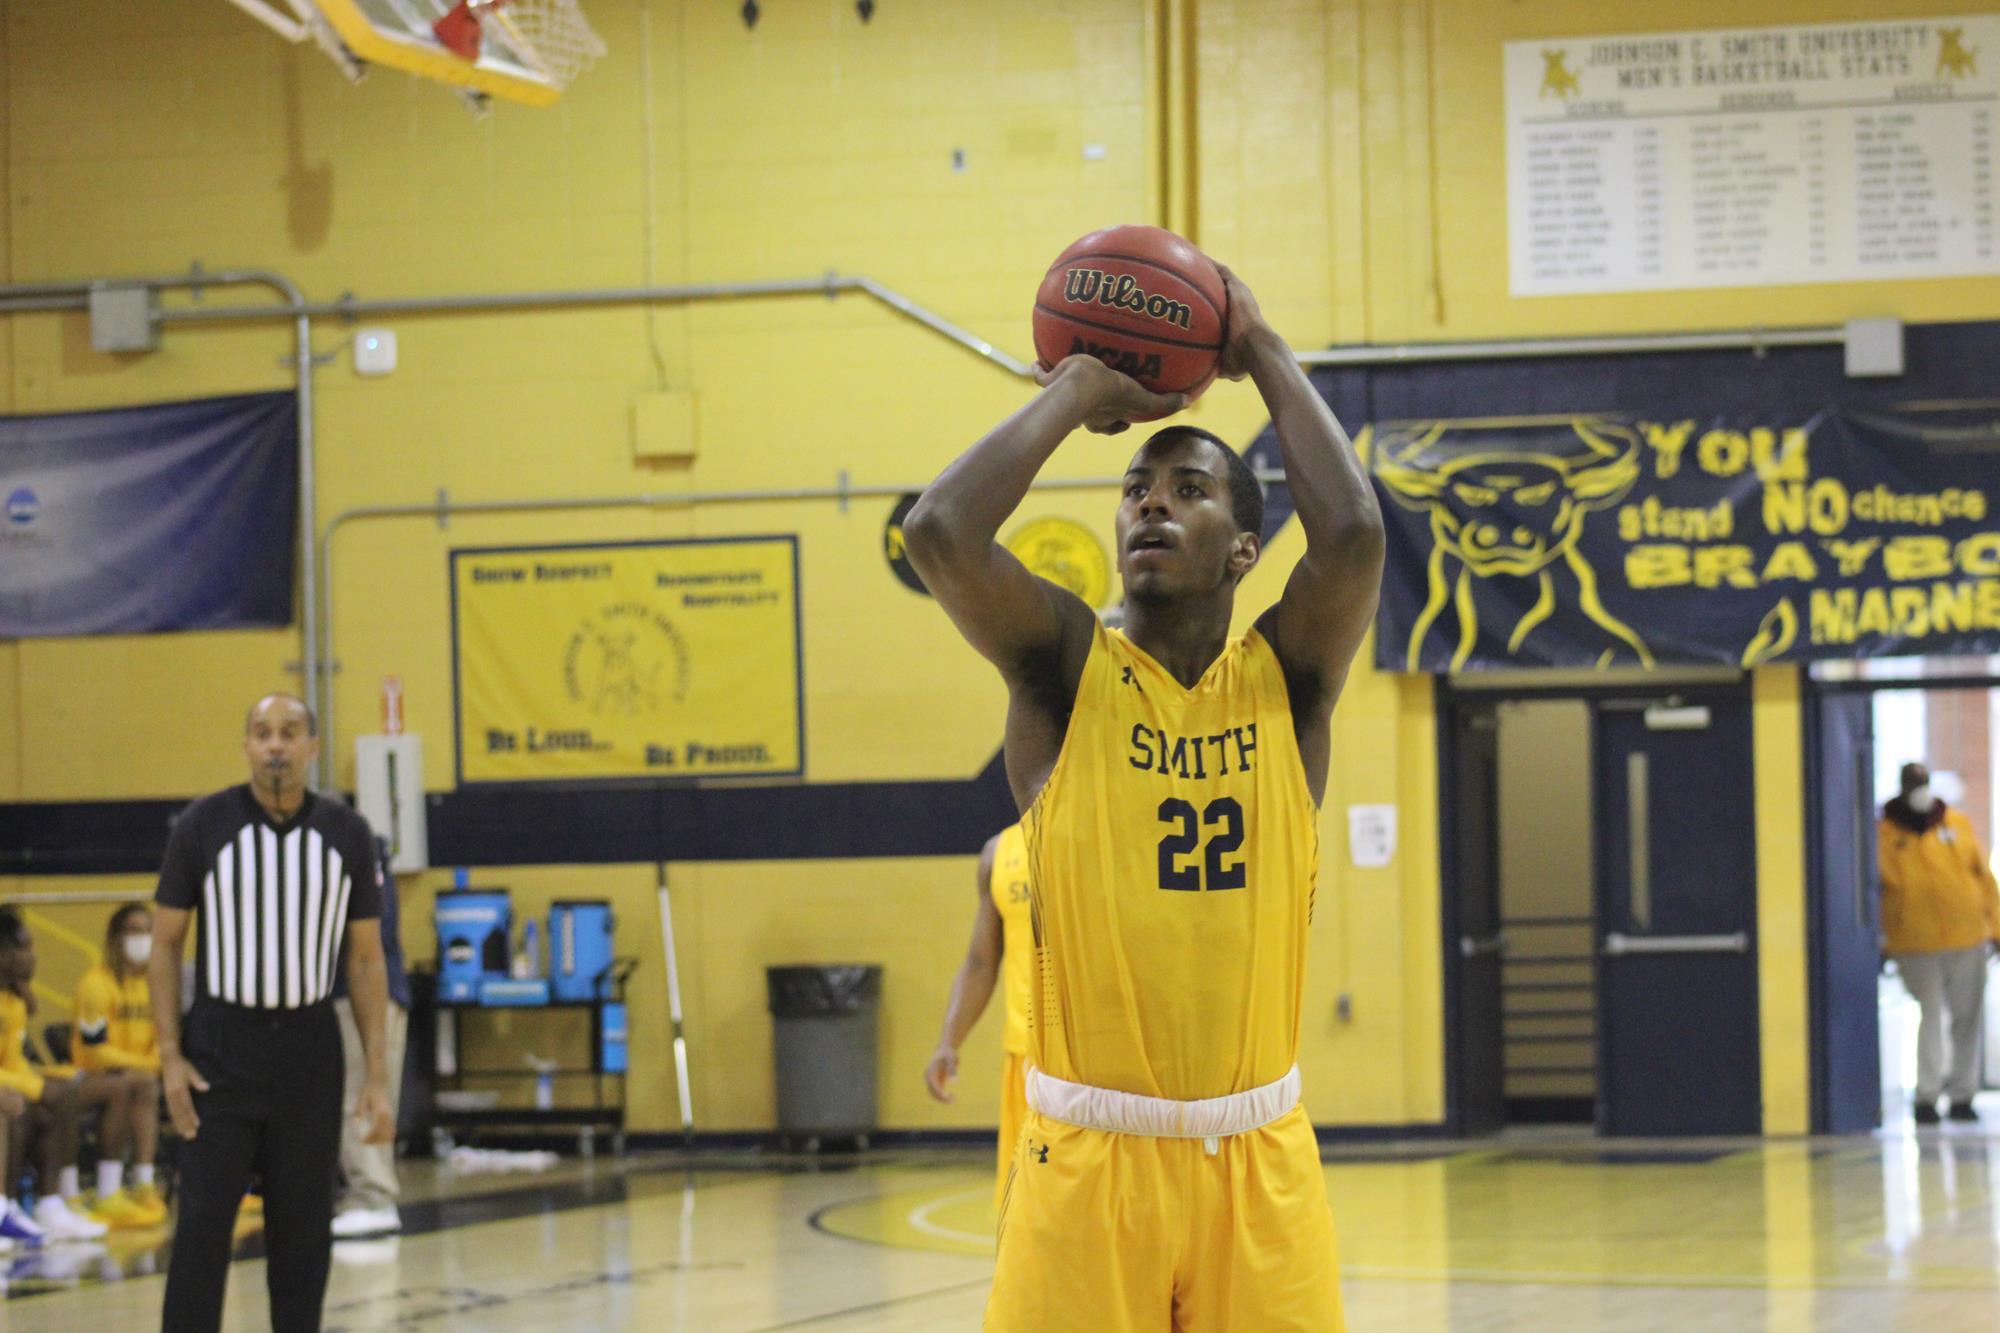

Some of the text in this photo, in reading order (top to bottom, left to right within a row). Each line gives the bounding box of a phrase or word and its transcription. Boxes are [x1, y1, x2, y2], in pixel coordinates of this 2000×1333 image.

[1588, 40, 1680, 66] JOHNSON
[1721, 32, 1788, 57] SMITH
[1800, 25, 1930, 54] UNIVERSITY
[1618, 51, 1912, 89] MEN'S BASKETBALL STATS
[1064, 268, 1191, 330] Wilson
[1637, 419, 1809, 481] YOU
[1617, 477, 1987, 541] stand NO chance
[1129, 723, 1257, 779] SMITH
[1157, 796, 1246, 891] 22
